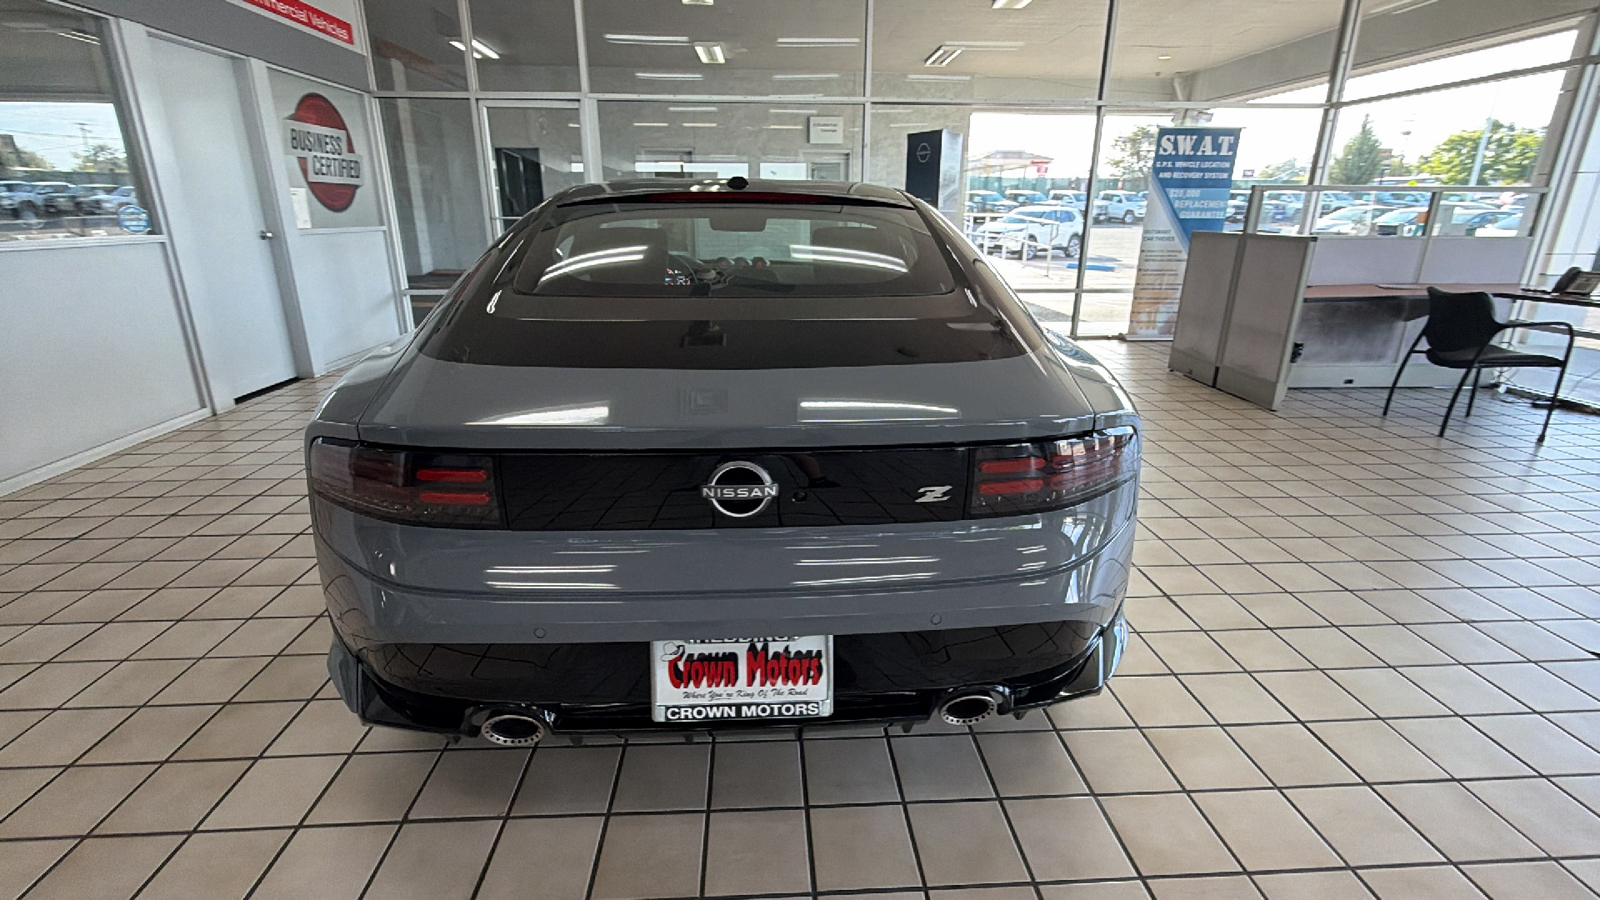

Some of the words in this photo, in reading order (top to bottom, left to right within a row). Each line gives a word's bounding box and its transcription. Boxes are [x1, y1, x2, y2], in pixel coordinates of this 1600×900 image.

[307, 11, 349, 39] Vehicles
[291, 128, 342, 155] BUSINESS
[312, 155, 361, 179] CERTIFIED
[702, 485, 777, 498] NISSAN
[914, 485, 953, 503] Z
[668, 644, 739, 689] Crown
[746, 643, 824, 688] Motors
[757, 690, 769, 699] Of
[770, 687, 784, 696] The
[666, 706, 736, 720] CROWN
[741, 703, 819, 717] MOTORS
